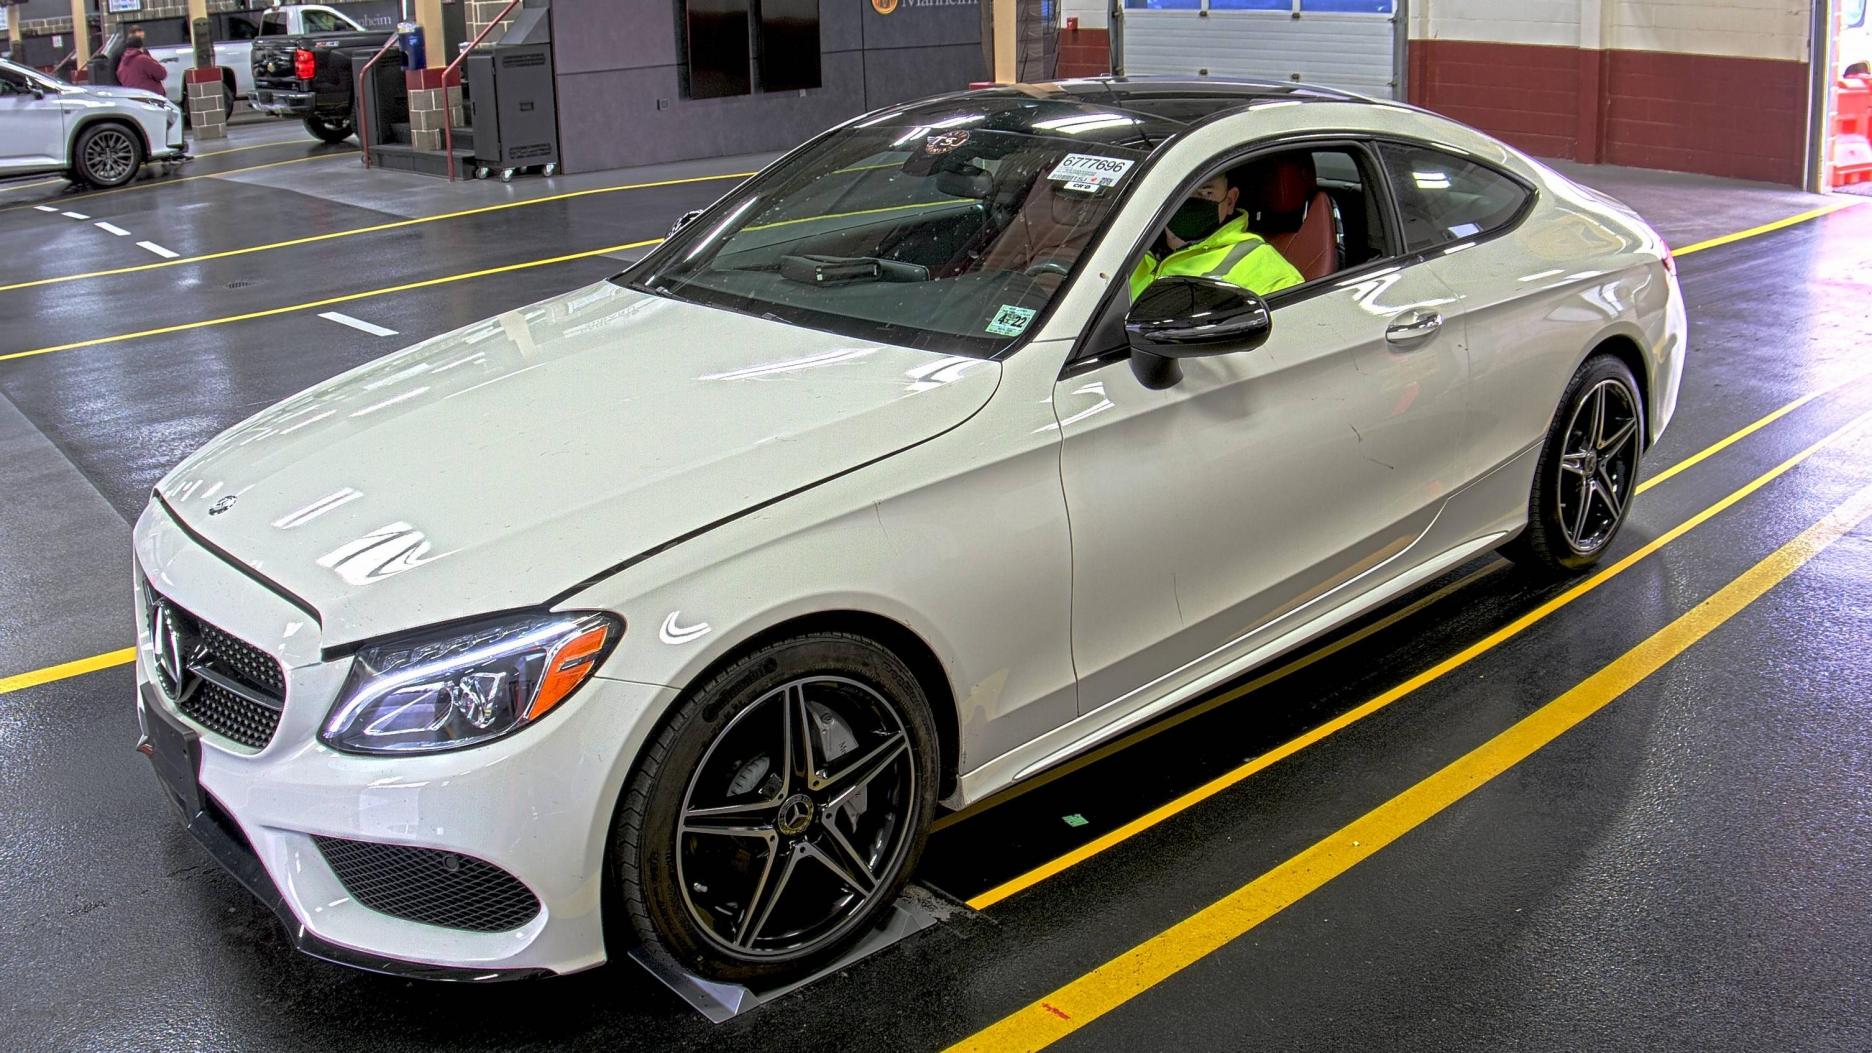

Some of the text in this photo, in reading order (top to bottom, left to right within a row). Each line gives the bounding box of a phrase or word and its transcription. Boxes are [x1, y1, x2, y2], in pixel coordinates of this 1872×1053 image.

[1063, 156, 1125, 172] 6777696
[997, 314, 1027, 328] 4 22
